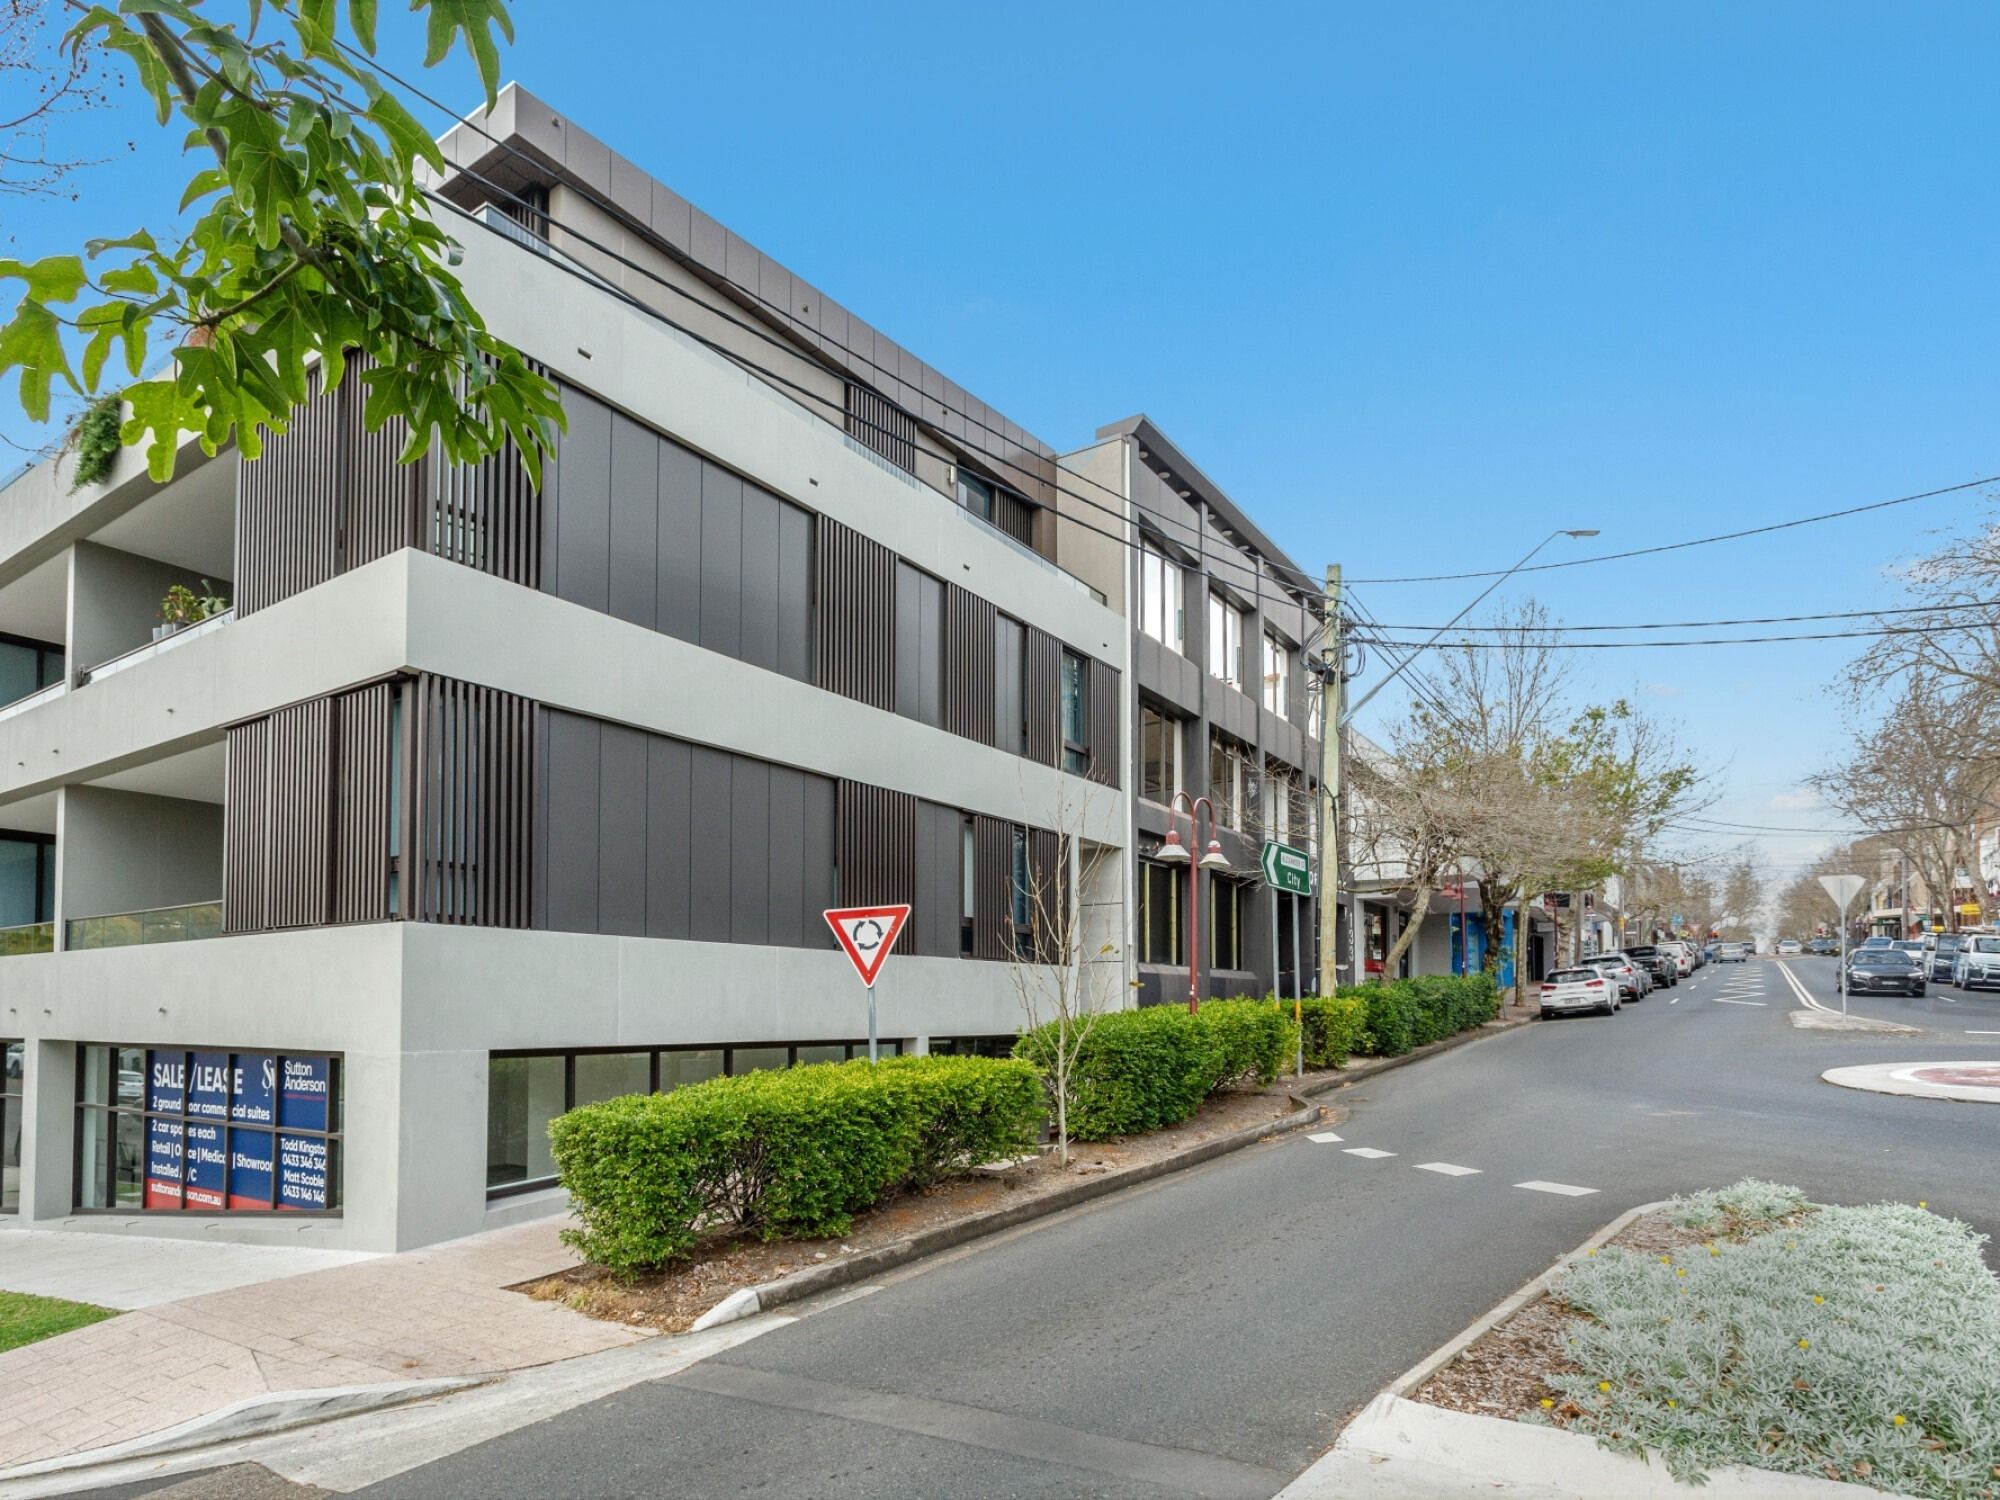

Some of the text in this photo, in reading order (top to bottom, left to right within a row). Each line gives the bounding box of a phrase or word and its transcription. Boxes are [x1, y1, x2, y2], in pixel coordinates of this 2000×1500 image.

[1288, 872, 1300, 889] City
[153, 1062, 185, 1089] SALE
[285, 1060, 313, 1077] Sutton
[284, 1076, 326, 1093] Anderson
[152, 1096, 158, 1108] 2
[158, 1097, 182, 1112] ground
[202, 1103, 246, 1118] commecial
[247, 1105, 270, 1121] suites
[152, 1119, 217, 1140] 2 car spaes each
[152, 1140, 171, 1155] Retail
[201, 1148, 227, 1165] Medica
[280, 1137, 298, 1151] Todd
[152, 1160, 179, 1178] Installed
[282, 1153, 299, 1167] 0433
[300, 1155, 313, 1169] 346
[283, 1169, 325, 1188] Matt Scoble
[282, 1185, 326, 1203] 0433 146 146
